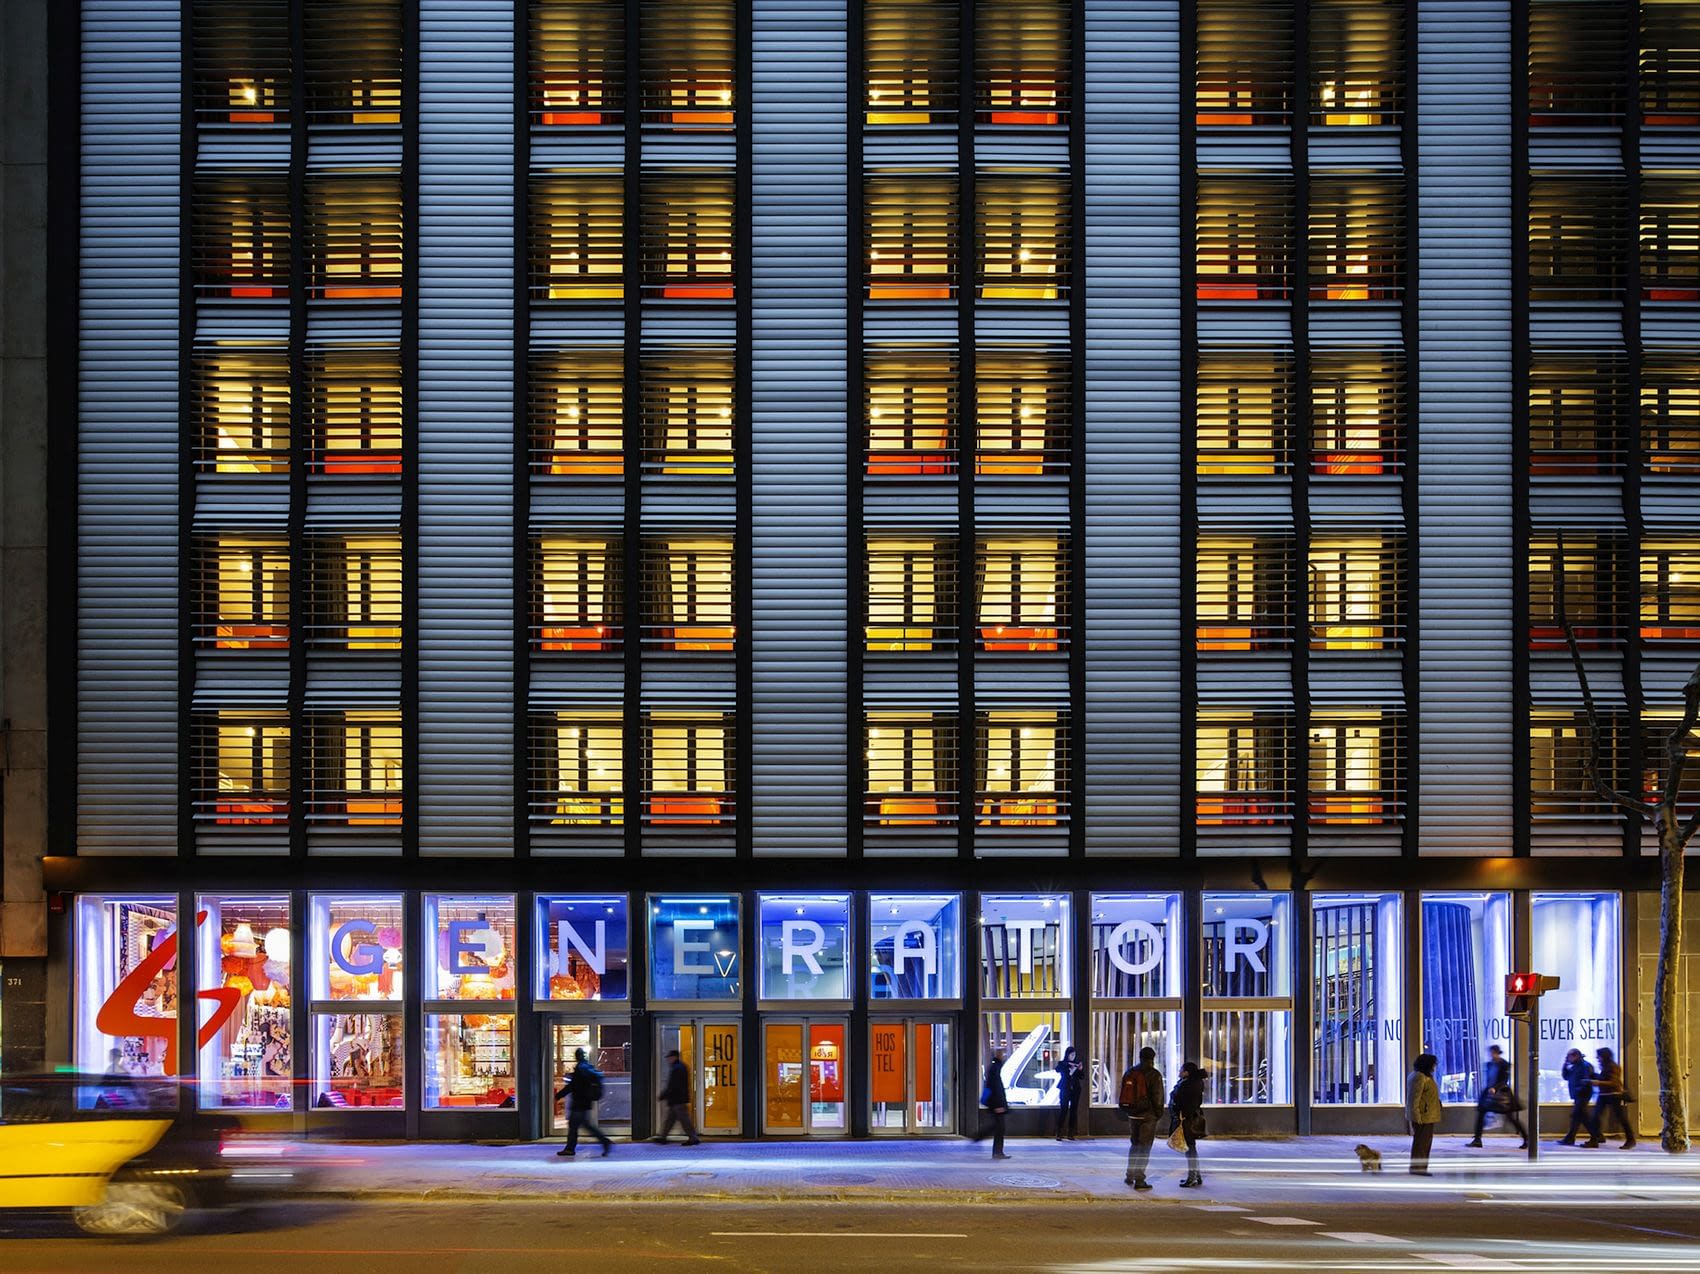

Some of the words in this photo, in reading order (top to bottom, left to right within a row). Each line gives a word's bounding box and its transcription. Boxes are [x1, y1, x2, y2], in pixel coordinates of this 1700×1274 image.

[331, 918, 1269, 976] GENERATOR
[7, 978, 22, 986] 371
[1424, 1018, 1477, 1041] HOSTEL
[1540, 1018, 1574, 1040] EVER
[1580, 1018, 1615, 1040] SEEN
[713, 1033, 734, 1062] HO
[875, 1032, 896, 1052] HOS
[874, 1053, 896, 1073] TEL
[712, 1063, 736, 1087] TEL
